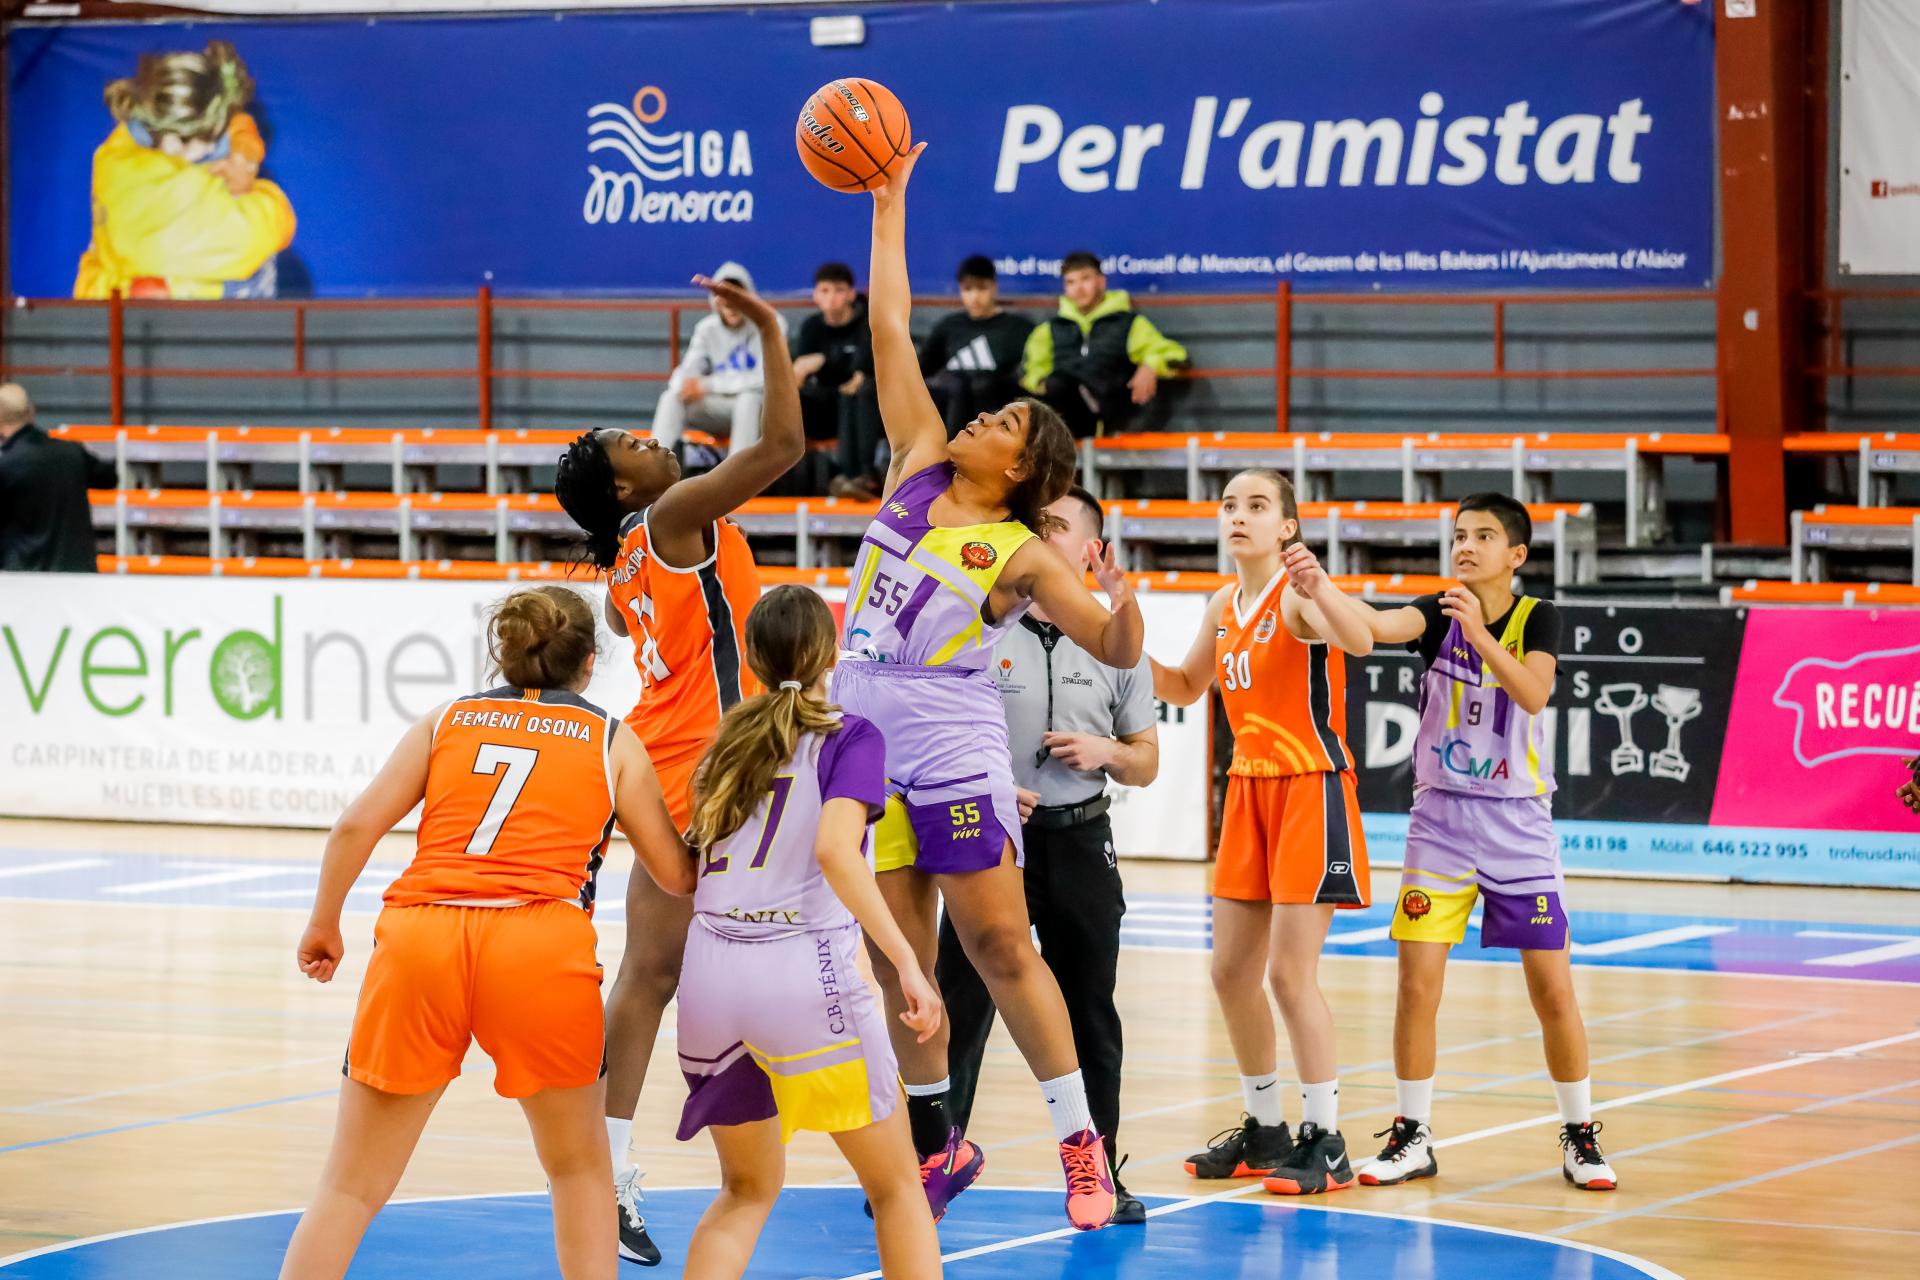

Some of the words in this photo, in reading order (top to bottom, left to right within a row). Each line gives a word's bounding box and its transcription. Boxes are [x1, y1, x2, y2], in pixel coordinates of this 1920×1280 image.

[994, 105, 1164, 193] Per
[583, 165, 754, 224] Menorca
[1118, 255, 1176, 274] Consell
[1178, 255, 1199, 273] de
[1293, 253, 1354, 273] Govern
[1355, 253, 1378, 271] de
[1379, 252, 1403, 271] les
[1405, 252, 1438, 270] Illes
[1440, 251, 1499, 270] Balears
[868, 571, 909, 617] 55
[2, 594, 484, 724] verdnei
[1222, 650, 1252, 691] 30
[1061, 676, 1093, 687] SPALDING
[451, 710, 524, 730] FEMENÍ
[526, 716, 591, 742] OSONA
[1467, 701, 1483, 726] 9
[12, 742, 180, 769] CARPINTERÍA
[188, 748, 220, 772] DE
[101, 782, 223, 808] MUEBLES
[231, 787, 262, 811] DE
[269, 788, 348, 813] COCIN
[464, 742, 540, 856] 7
[949, 802, 981, 826] 55
[1584, 835, 1603, 852] 81
[1606, 836, 1629, 854] 98
[1702, 839, 1736, 857] 646
[1740, 841, 1771, 858] 522
[1776, 842, 1809, 860] 995
[1536, 895, 1549, 914] 9
[817, 938, 841, 998] FÉNIX
